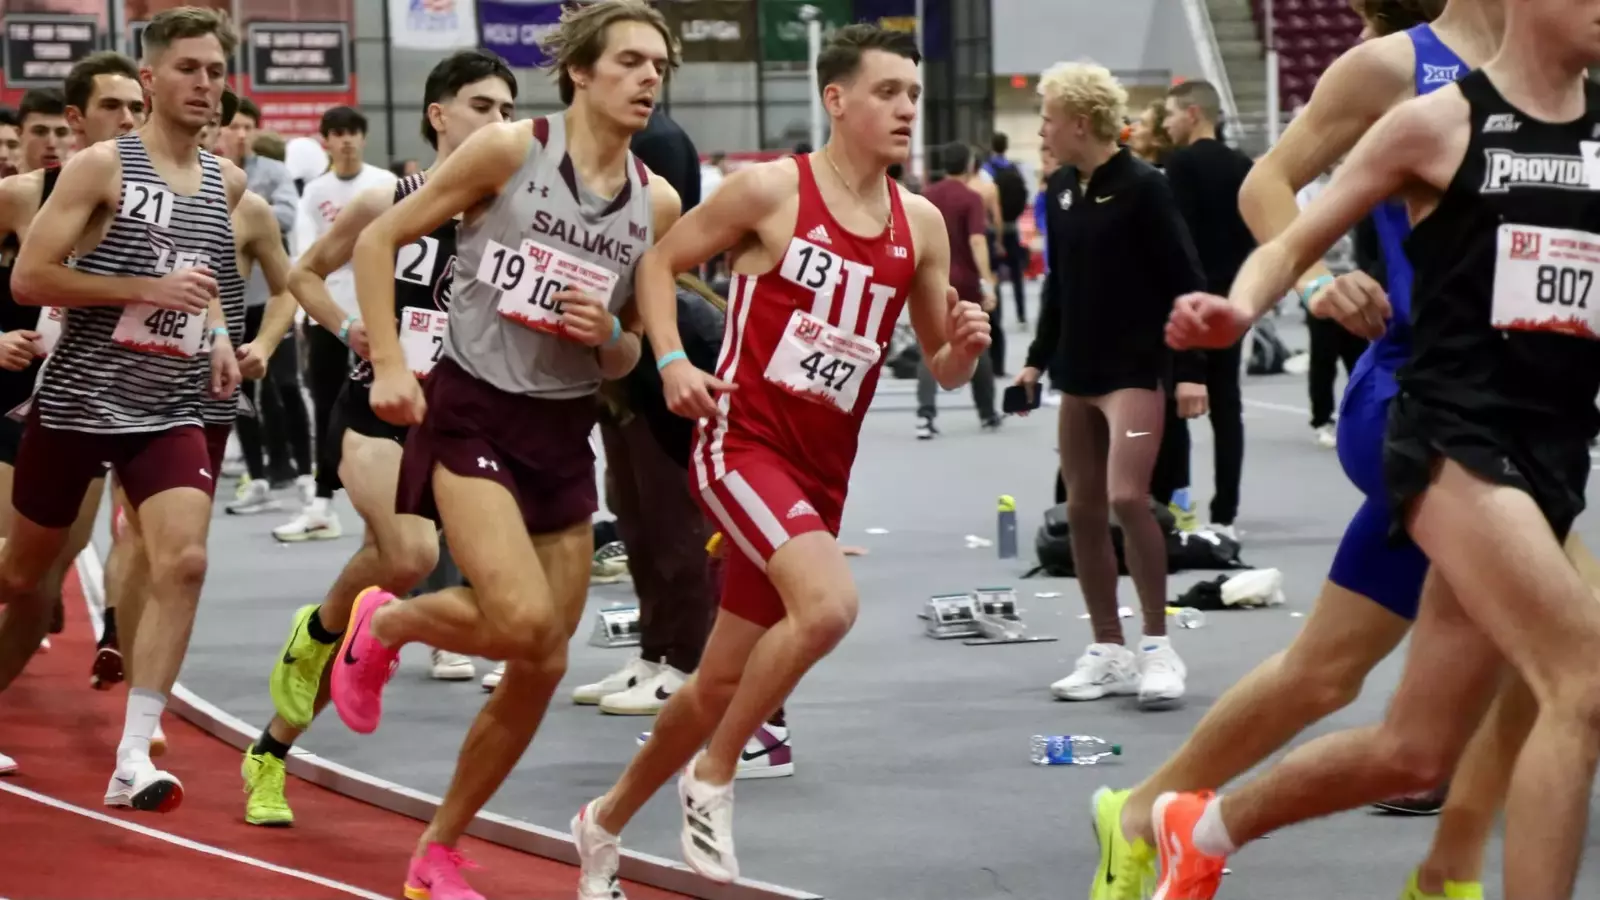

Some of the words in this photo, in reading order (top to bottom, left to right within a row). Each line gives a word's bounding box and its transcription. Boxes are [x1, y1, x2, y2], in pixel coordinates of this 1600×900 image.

[1486, 151, 1590, 190] PROVID
[129, 187, 164, 224] 21
[532, 210, 633, 266] SALUKIS
[402, 238, 428, 282] 2
[491, 249, 525, 291] 19
[796, 246, 833, 289] 13
[1536, 265, 1594, 309] 807
[144, 308, 188, 339] 482
[800, 351, 857, 392] 447
